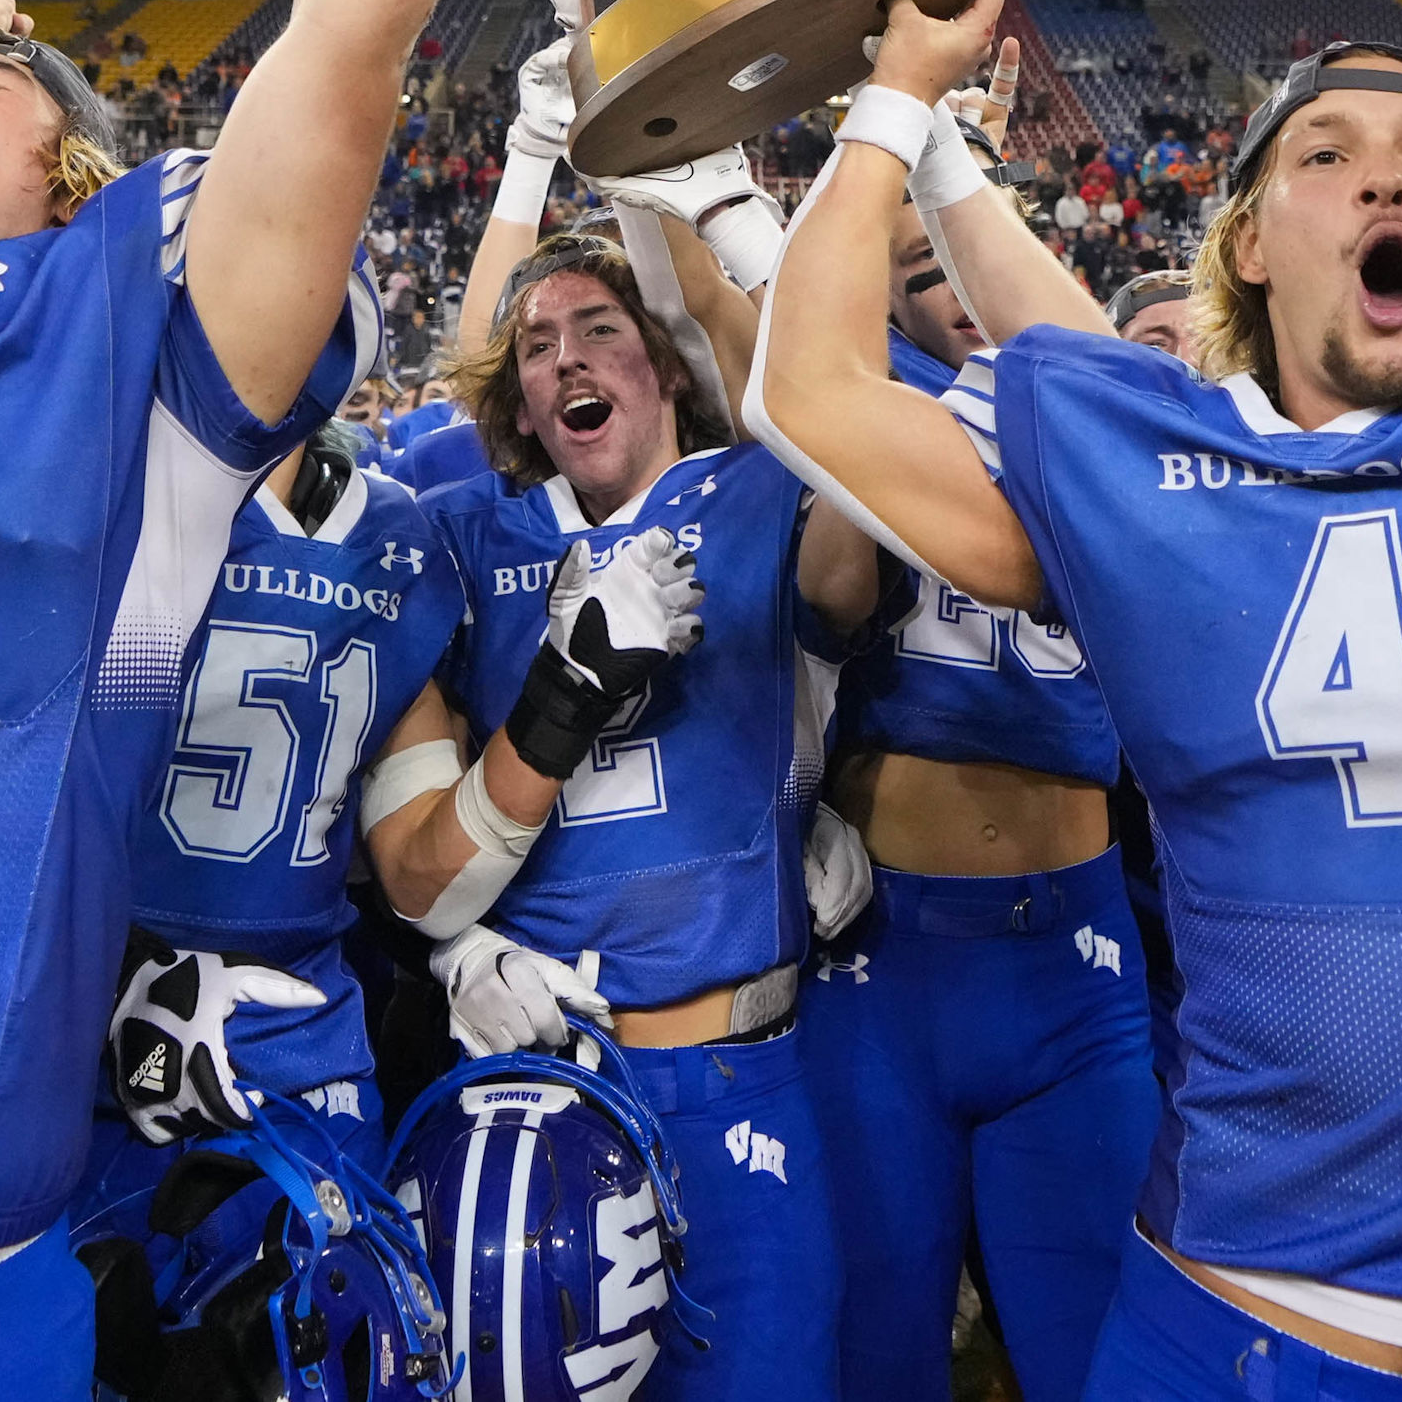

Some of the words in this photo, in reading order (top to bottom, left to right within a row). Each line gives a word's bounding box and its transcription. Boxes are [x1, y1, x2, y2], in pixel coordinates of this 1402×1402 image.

[224, 563, 402, 622] ULLDOGS
[158, 619, 377, 868] 51
[128, 1042, 166, 1088] adidas
[483, 1091, 542, 1105] DAWGS
